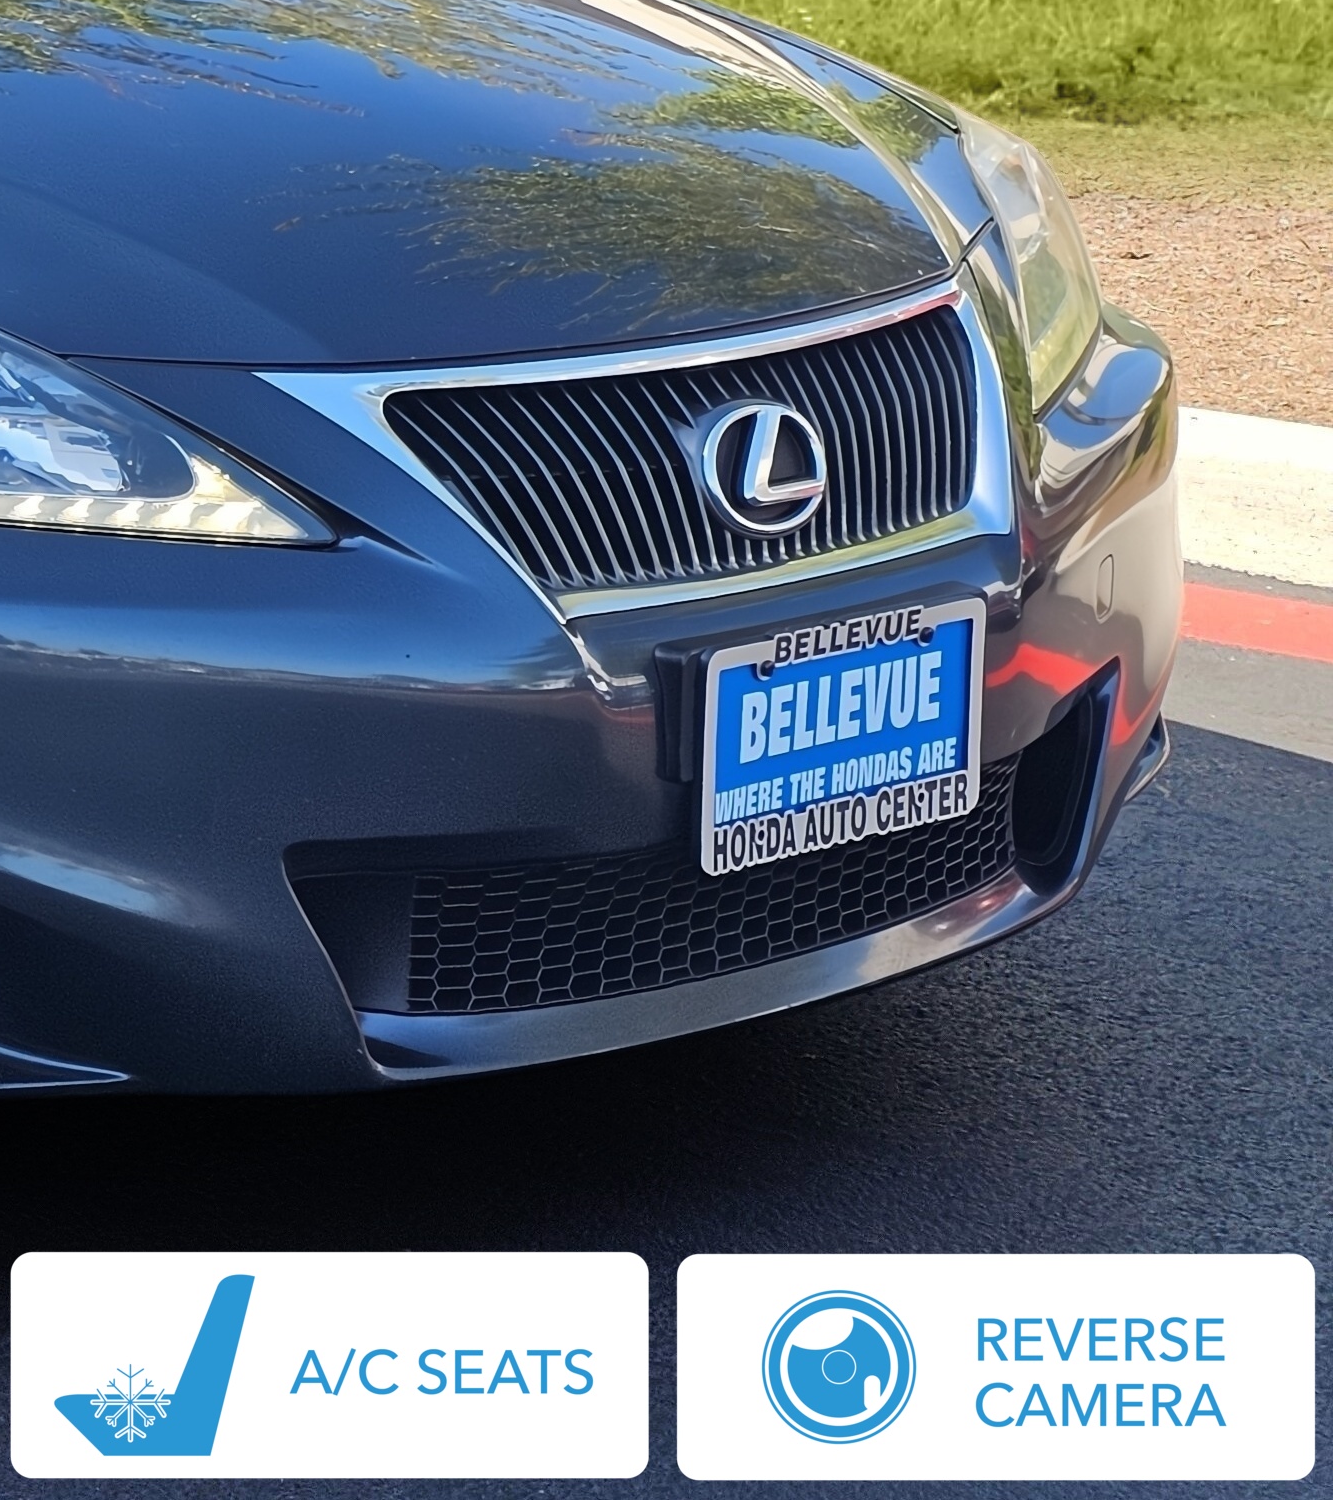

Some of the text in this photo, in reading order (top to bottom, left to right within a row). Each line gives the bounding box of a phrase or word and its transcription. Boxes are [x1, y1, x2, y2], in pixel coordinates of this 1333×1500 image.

[774, 608, 922, 663] BELLEVUE
[739, 650, 942, 764] BELLEVUE
[713, 772, 969, 872] HONDA AUTO CENTER
[715, 737, 957, 825] WHERE THE HONDAS ARE
